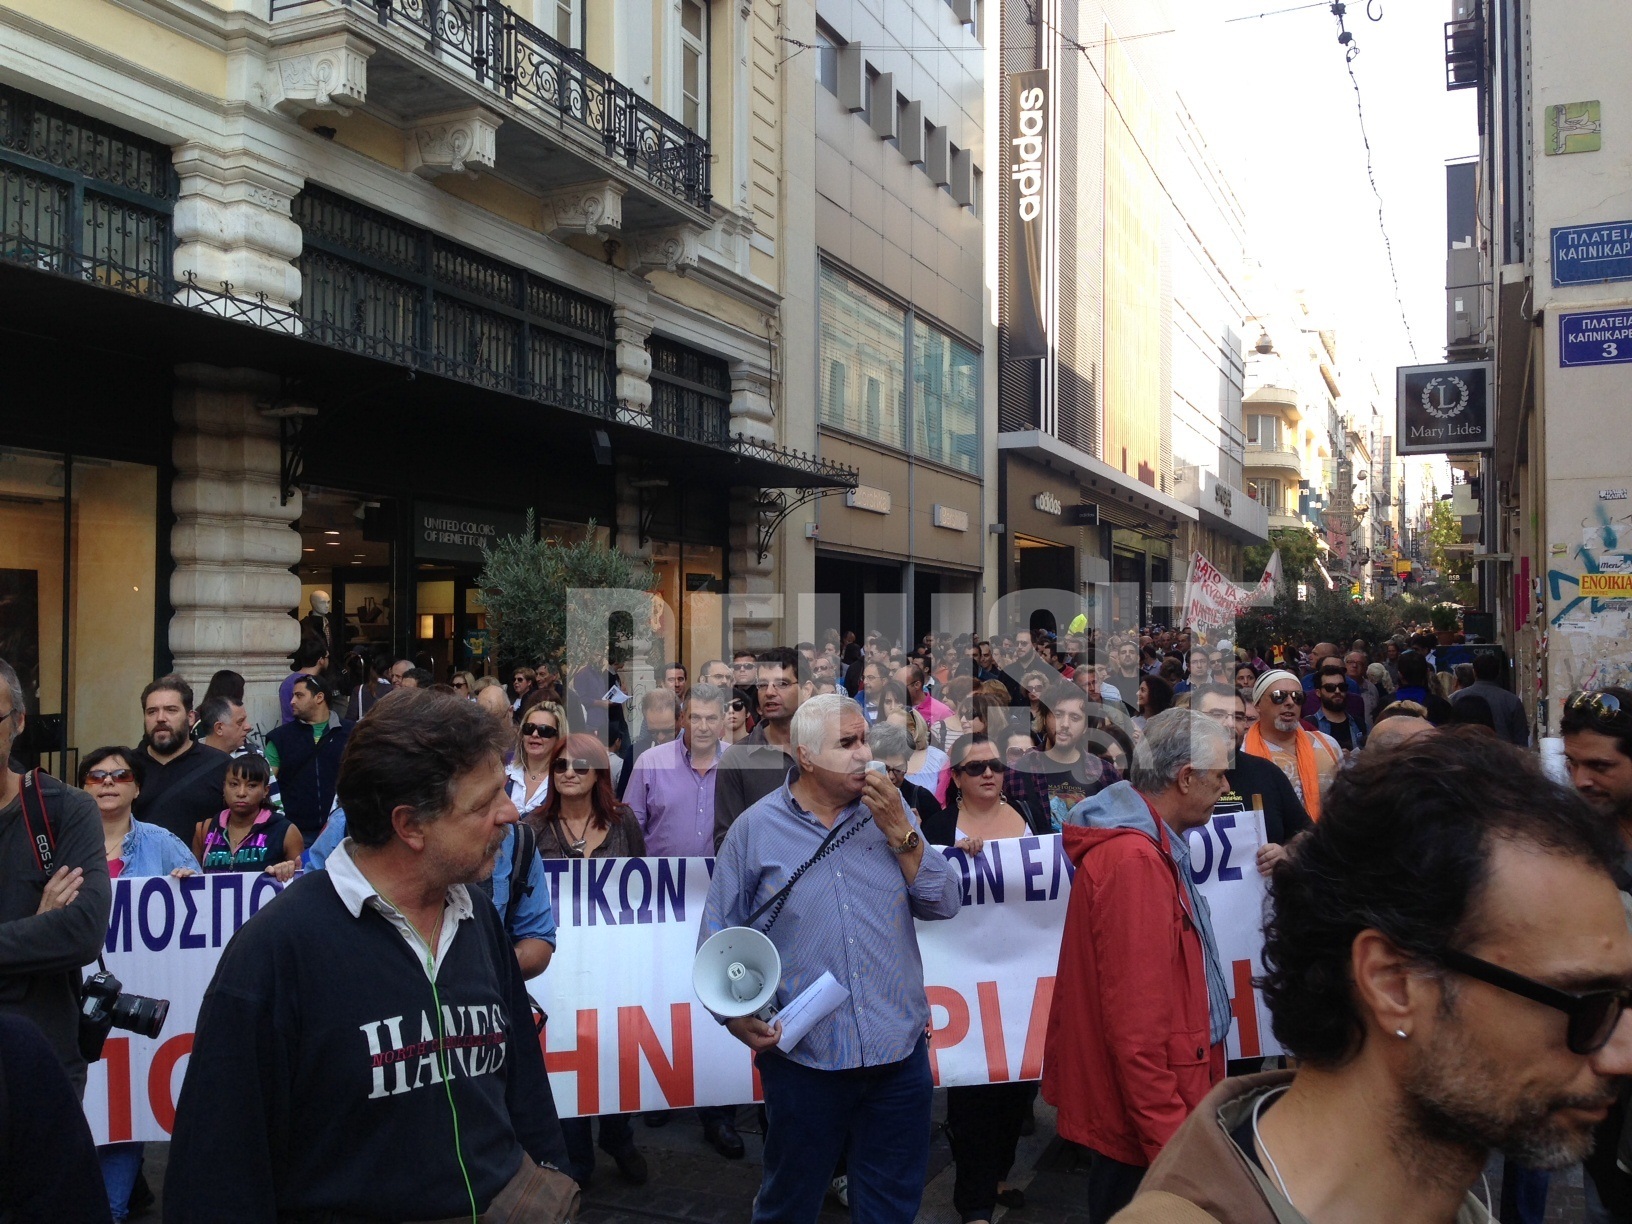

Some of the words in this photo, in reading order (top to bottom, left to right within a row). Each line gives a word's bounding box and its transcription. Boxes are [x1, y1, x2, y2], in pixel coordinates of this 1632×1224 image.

[1012, 87, 1044, 222] adidas
[1602, 343, 1618, 358] 3
[1437, 385, 1456, 408] L
[1410, 425, 1444, 438] Mary
[1448, 423, 1481, 436] Lides
[1036, 491, 1061, 516] adidas
[424, 517, 459, 532] UNITED
[461, 521, 496, 536] COLORS
[424, 530, 437, 542] OF
[440, 531, 487, 548] BENETTON
[36, 834, 52, 861] EOS
[102, 868, 303, 953] ΜΟΣΠΟ
[544, 857, 687, 928] ΤΙΚΩΝ
[1018, 834, 1075, 902] ΕΛ
[359, 1003, 506, 1099] HANES
[371, 1041, 427, 1068] NORTH
